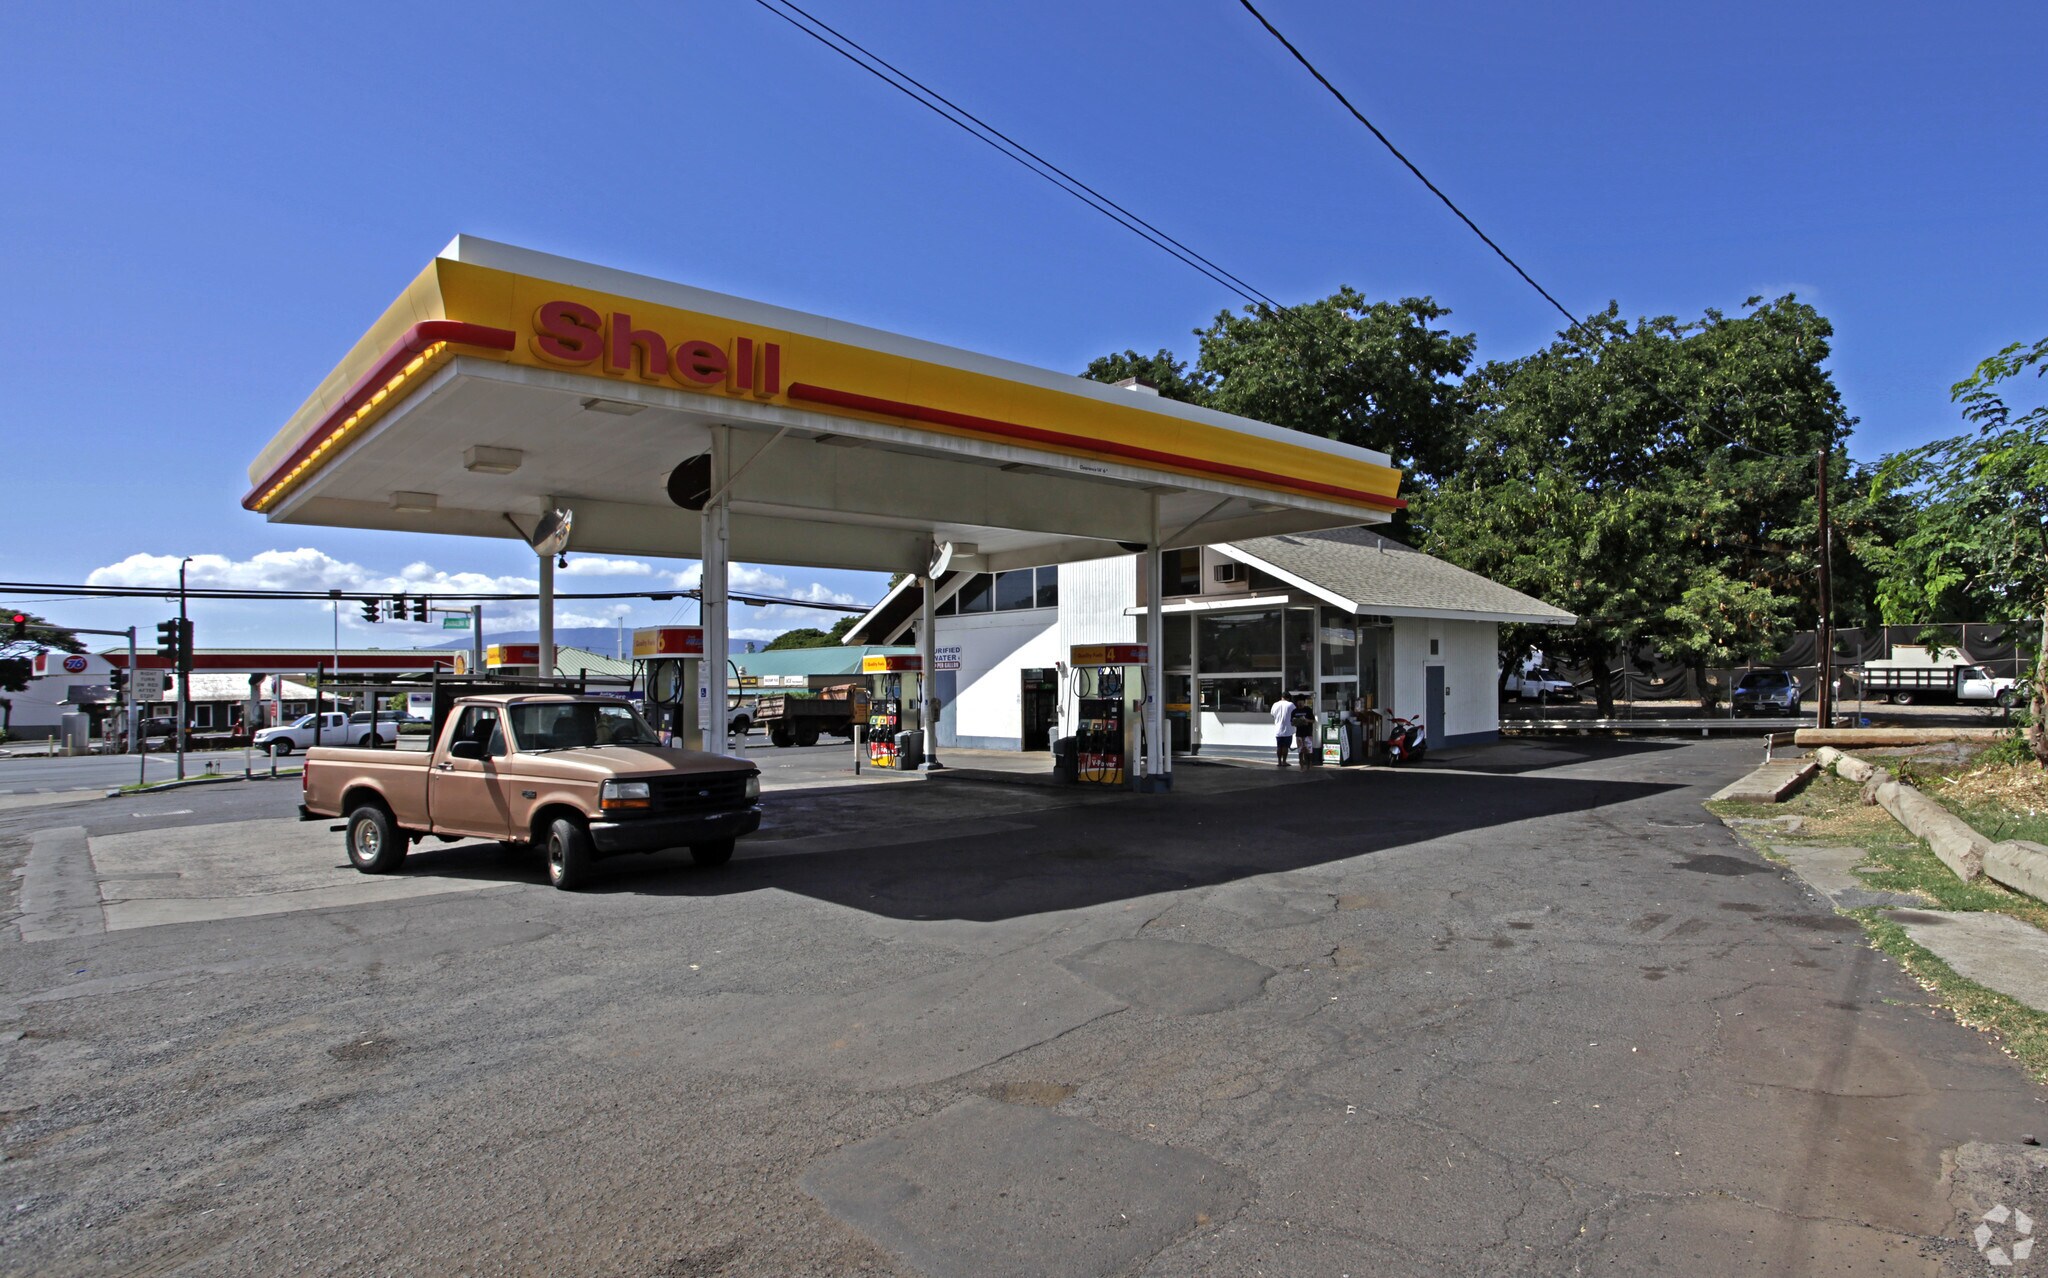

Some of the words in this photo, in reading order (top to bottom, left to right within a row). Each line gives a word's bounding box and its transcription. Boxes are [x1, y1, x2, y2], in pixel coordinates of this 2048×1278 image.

[531, 300, 781, 396] Shell
[658, 629, 666, 651] 6
[935, 646, 961, 654] URIFIED
[1107, 647, 1116, 661] 4
[66, 658, 84, 670] 76
